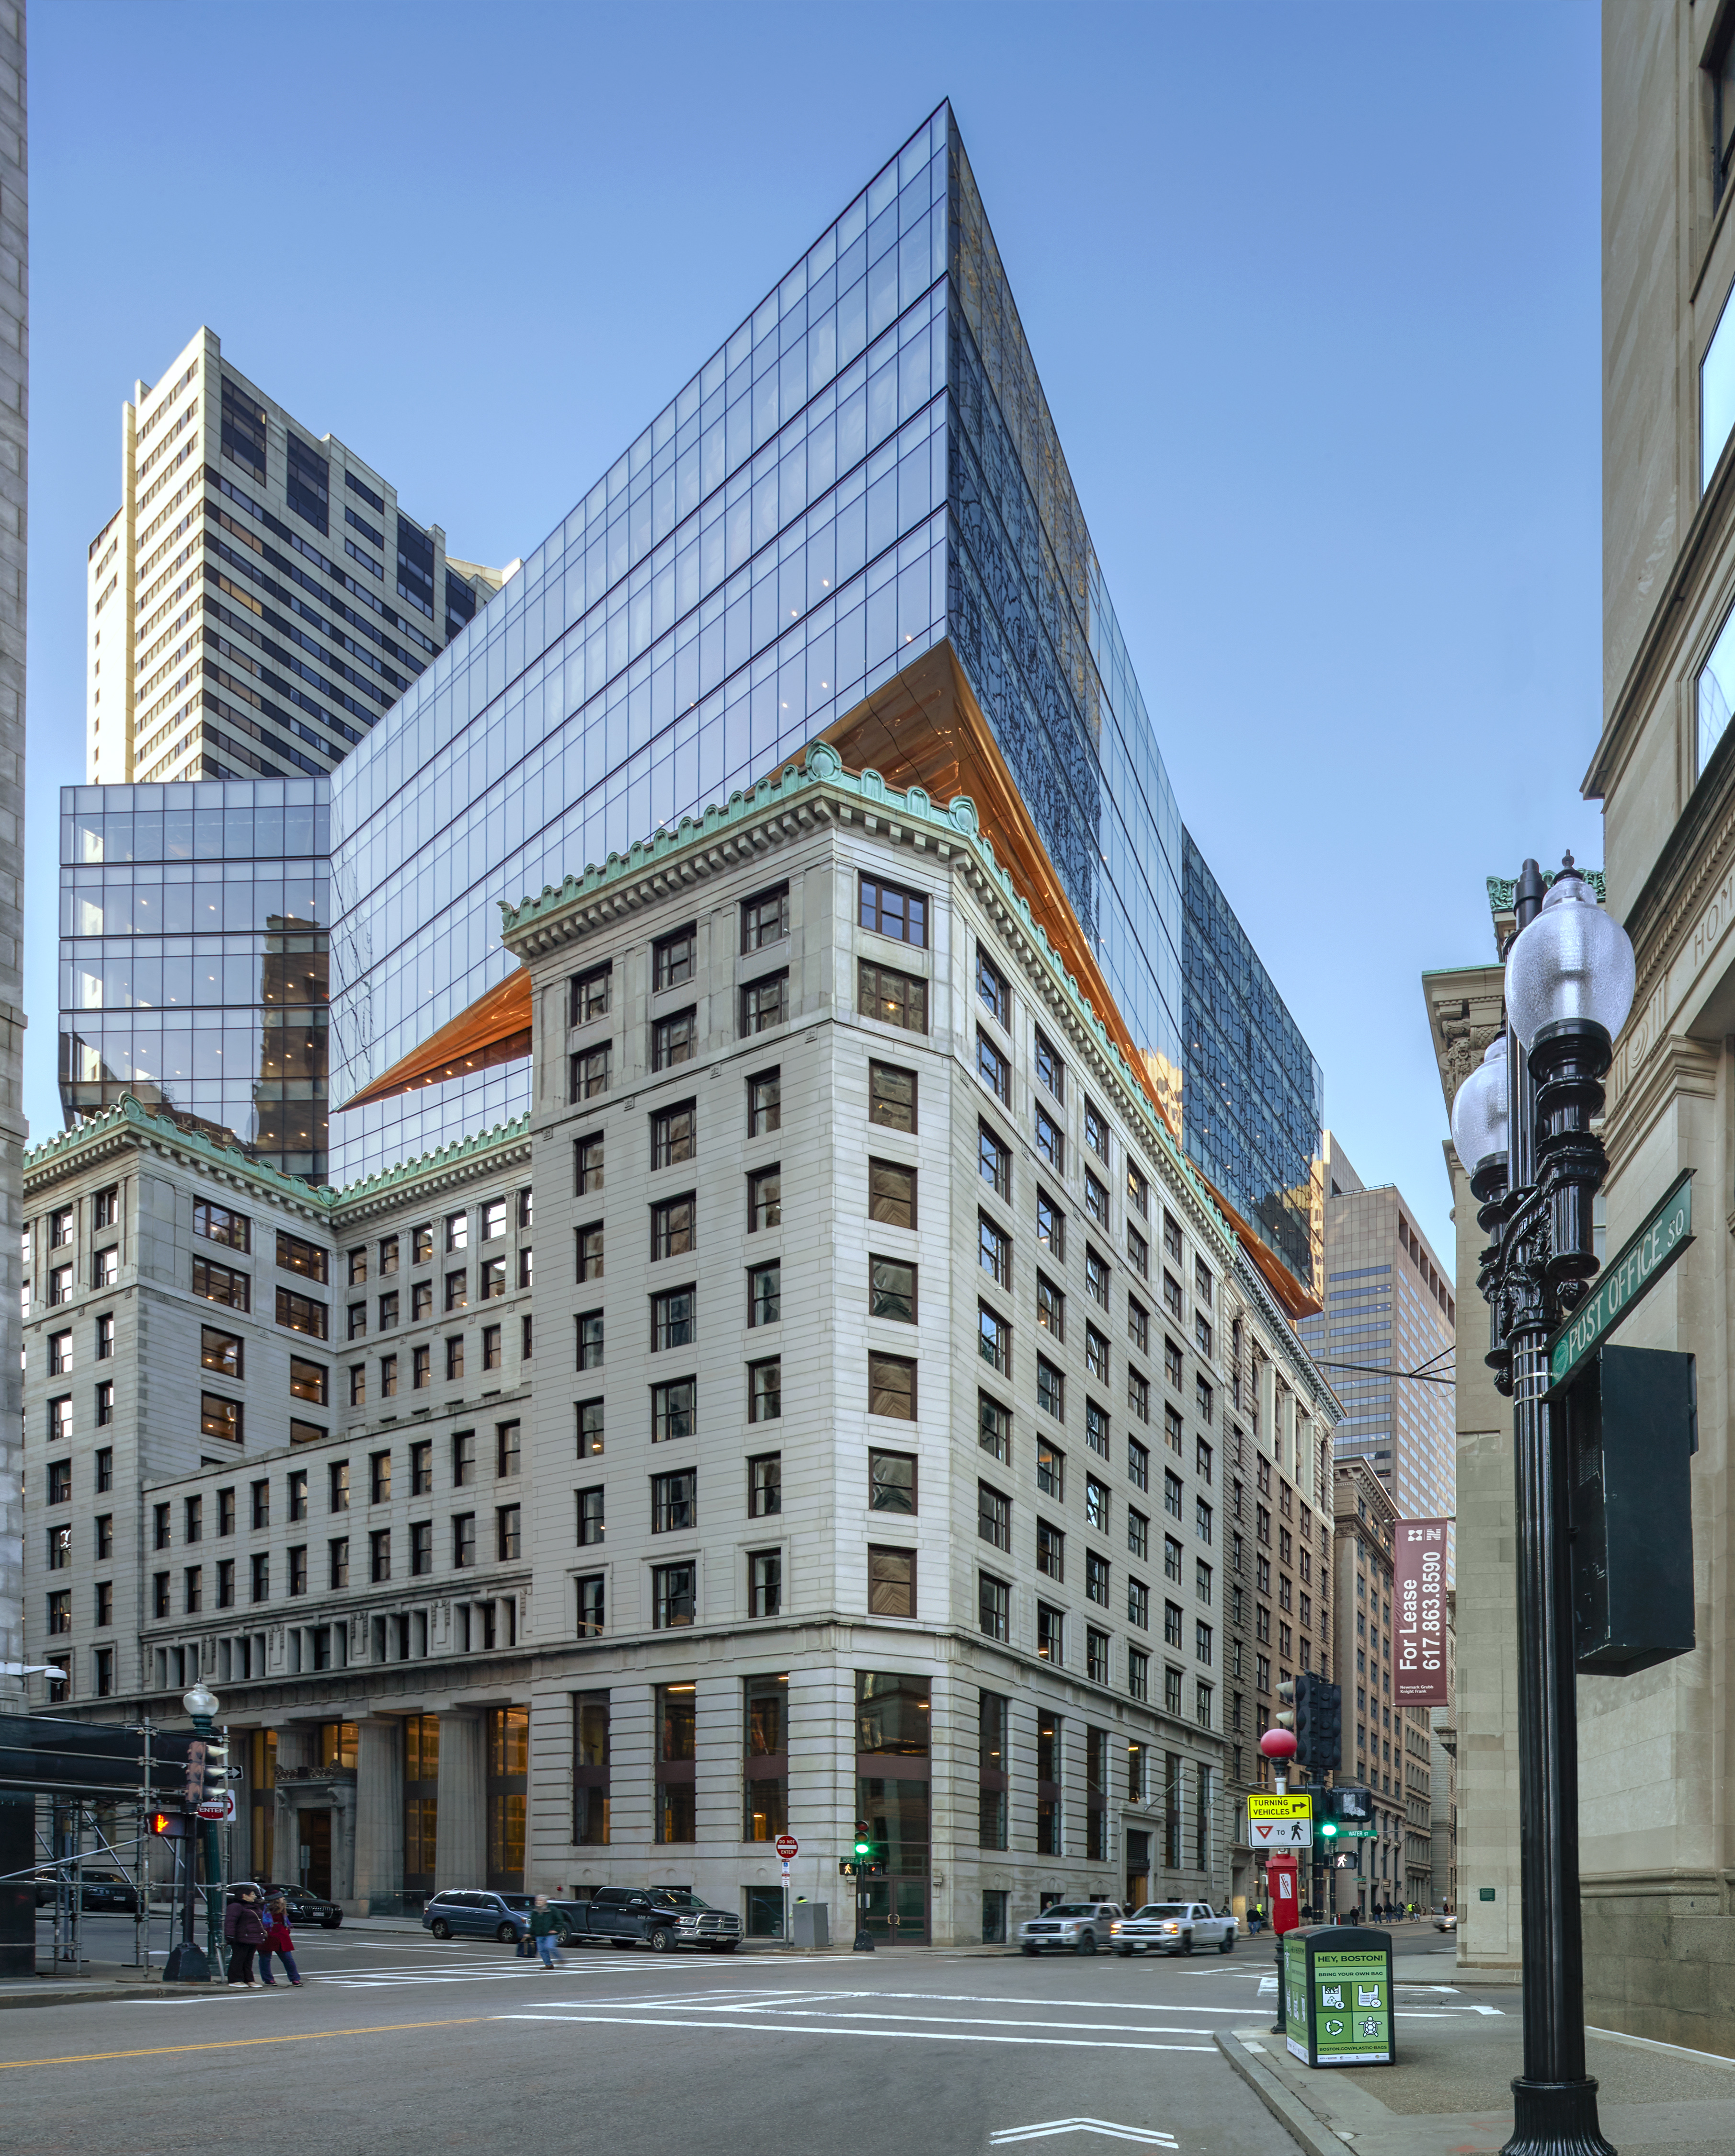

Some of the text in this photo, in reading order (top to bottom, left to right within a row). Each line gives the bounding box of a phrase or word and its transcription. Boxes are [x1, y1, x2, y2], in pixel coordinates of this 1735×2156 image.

[1569, 1209, 1684, 1365] POST OFFICE SQ
[1399, 1579, 1417, 1670] For Lease
[1422, 1551, 1441, 1670] 617.863.8590
